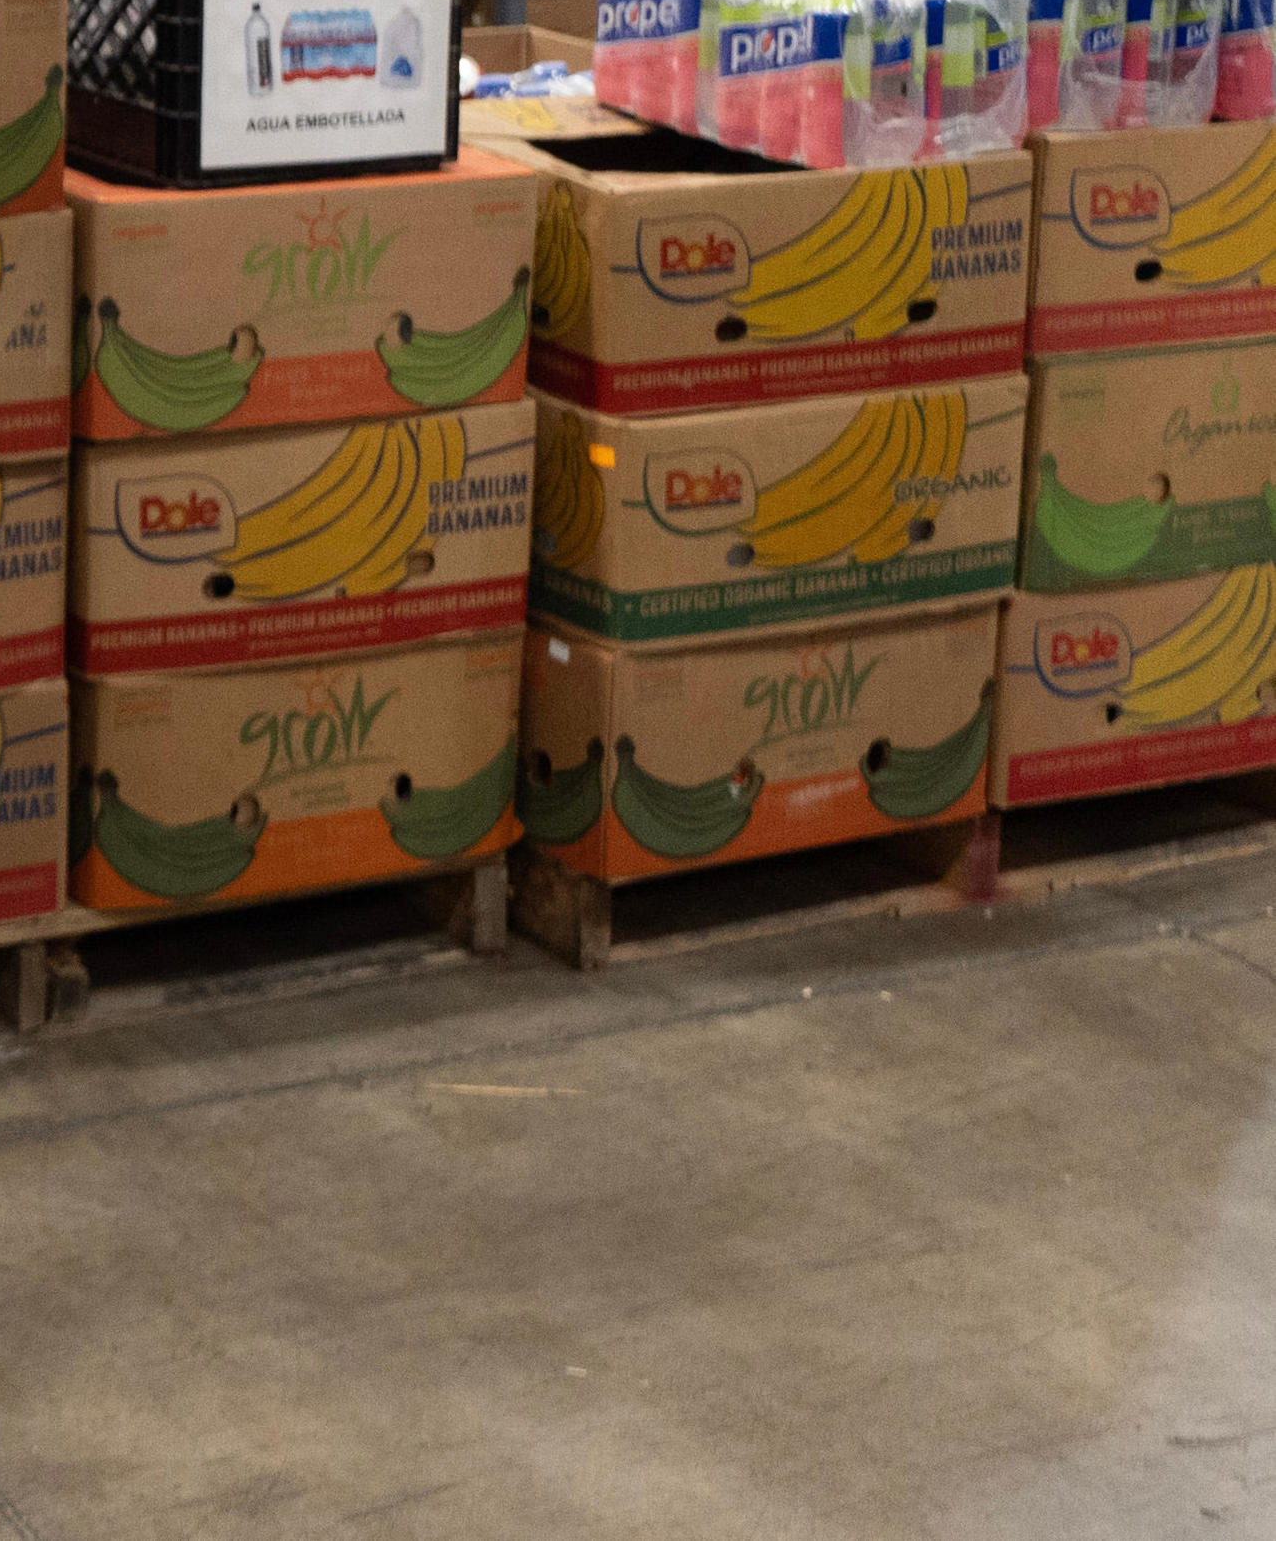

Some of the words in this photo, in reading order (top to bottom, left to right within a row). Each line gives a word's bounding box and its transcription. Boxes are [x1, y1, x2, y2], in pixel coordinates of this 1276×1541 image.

[246, 116, 290, 133] AGUA
[295, 109, 406, 130] EMBOTELLADA
[1091, 182, 1159, 218] Dole
[660, 232, 736, 272] Dole
[931, 219, 1023, 250] PREMIUM
[243, 213, 408, 310] grow
[930, 249, 1022, 282] BANANAS
[428, 473, 527, 507] PREMIUM
[665, 464, 742, 508] Dole
[894, 468, 1011, 504] ORGANIC
[140, 490, 221, 531] Dole
[427, 502, 526, 536] BANANAS
[640, 592, 719, 617] CERTIFIED
[724, 581, 789, 606] ORGANIC
[794, 570, 867, 598] BANANAS
[91, 628, 159, 651] PREMIUM
[162, 621, 238, 645] BANANAS
[250, 613, 316, 635] PREMIUM
[319, 604, 384, 627] BANANAS
[1051, 627, 1119, 667] Dole
[744, 640, 885, 745] grow
[240, 675, 402, 787] grow
